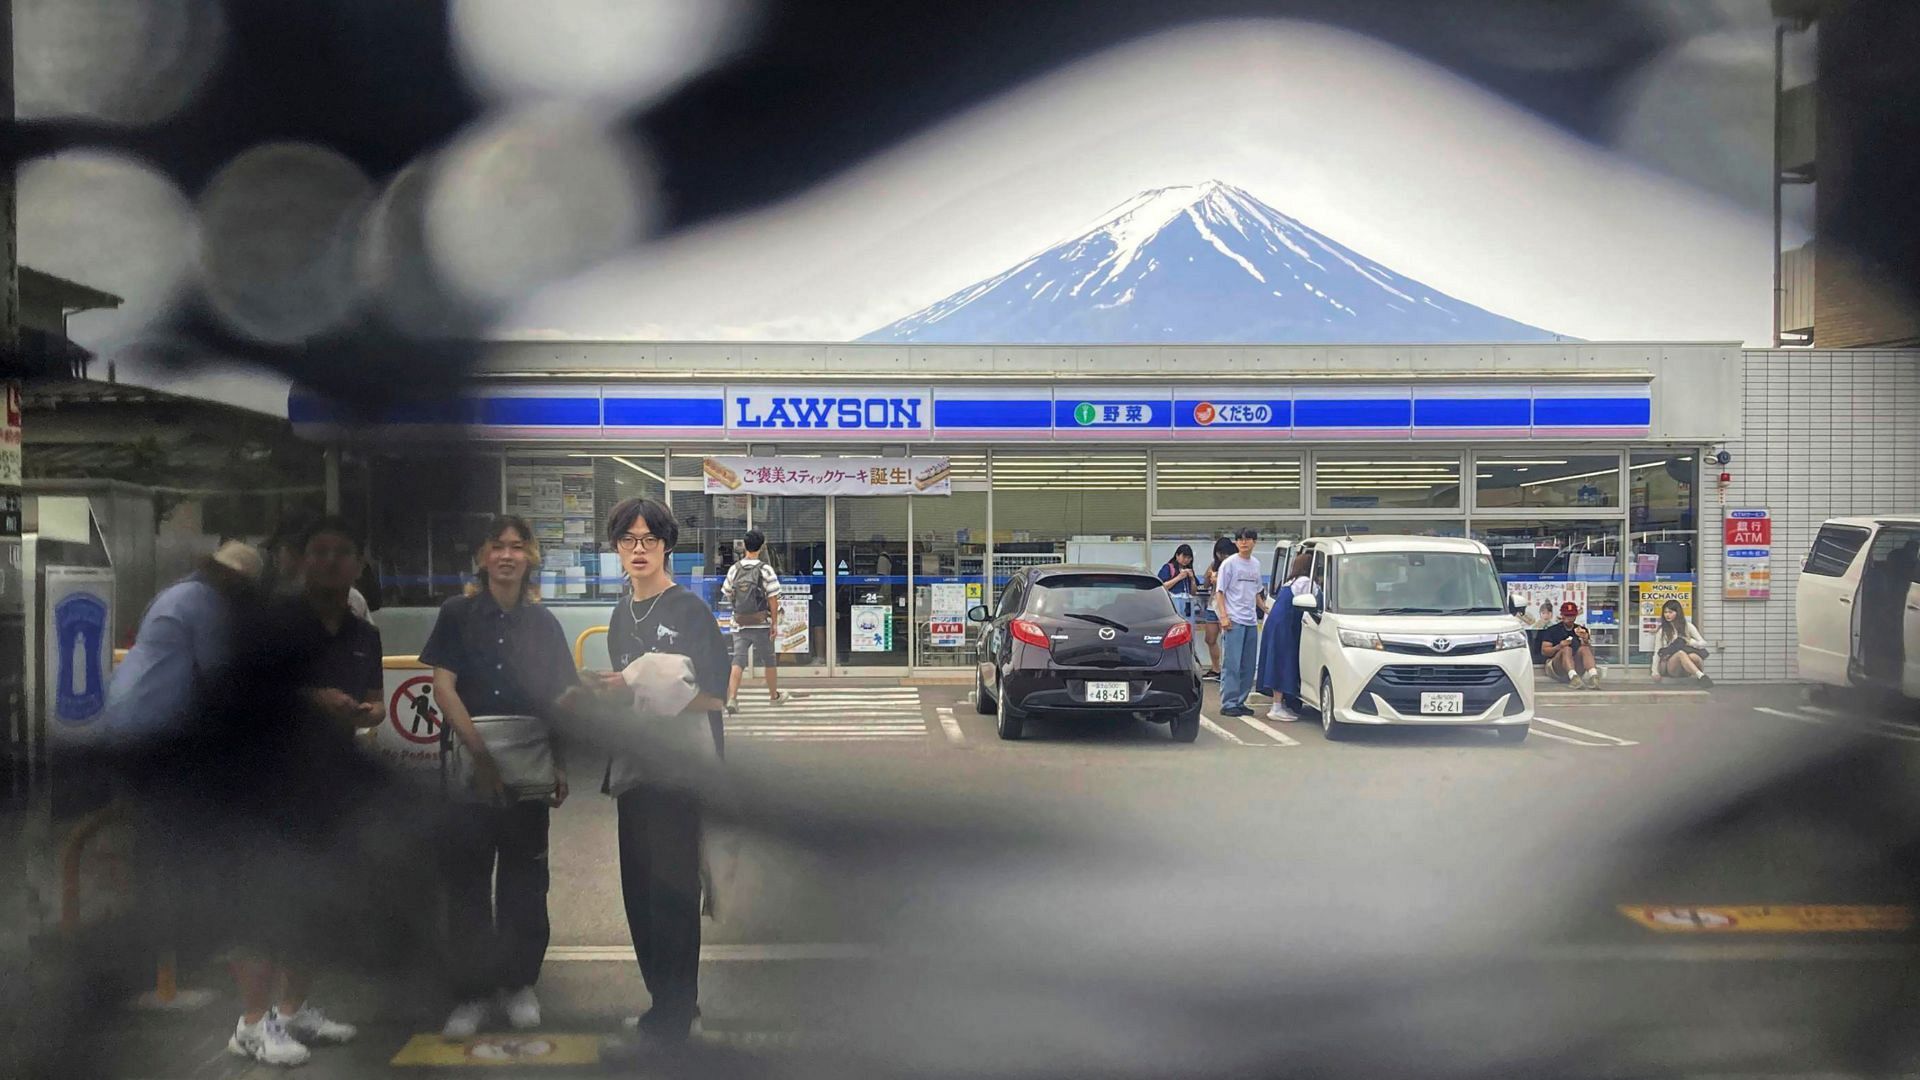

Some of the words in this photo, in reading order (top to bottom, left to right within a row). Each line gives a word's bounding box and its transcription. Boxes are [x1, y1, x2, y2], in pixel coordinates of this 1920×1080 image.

[736, 397, 922, 428] LAWSON
[1103, 405, 1142, 423] 野菜
[1218, 405, 1268, 421] くだもの
[1736, 521, 1761, 532] 銀行
[1734, 532, 1763, 543] ATM
[1641, 592, 1690, 600] EXCHANGE
[937, 624, 959, 633] ATM
[1095, 689, 1126, 701] 48-45
[1430, 701, 1459, 712] 56-21
